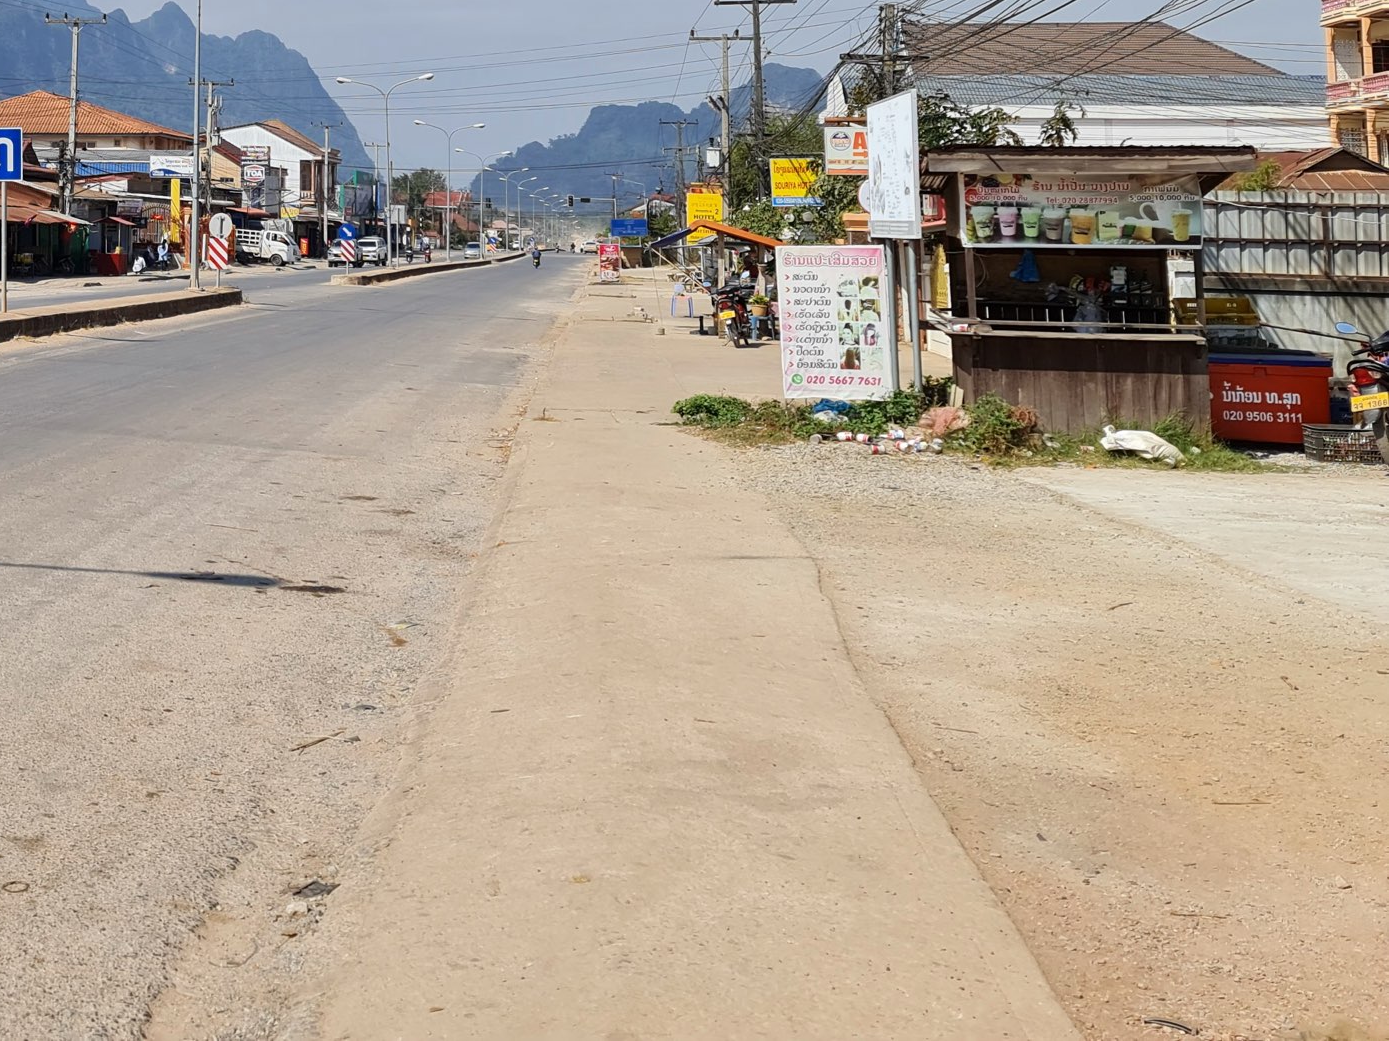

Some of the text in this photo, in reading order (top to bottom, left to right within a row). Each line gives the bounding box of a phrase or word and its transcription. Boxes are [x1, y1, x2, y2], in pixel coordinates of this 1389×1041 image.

[806, 375, 882, 386] 020 5667 7631
[1223, 410, 1303, 424] 020 9506 3111
